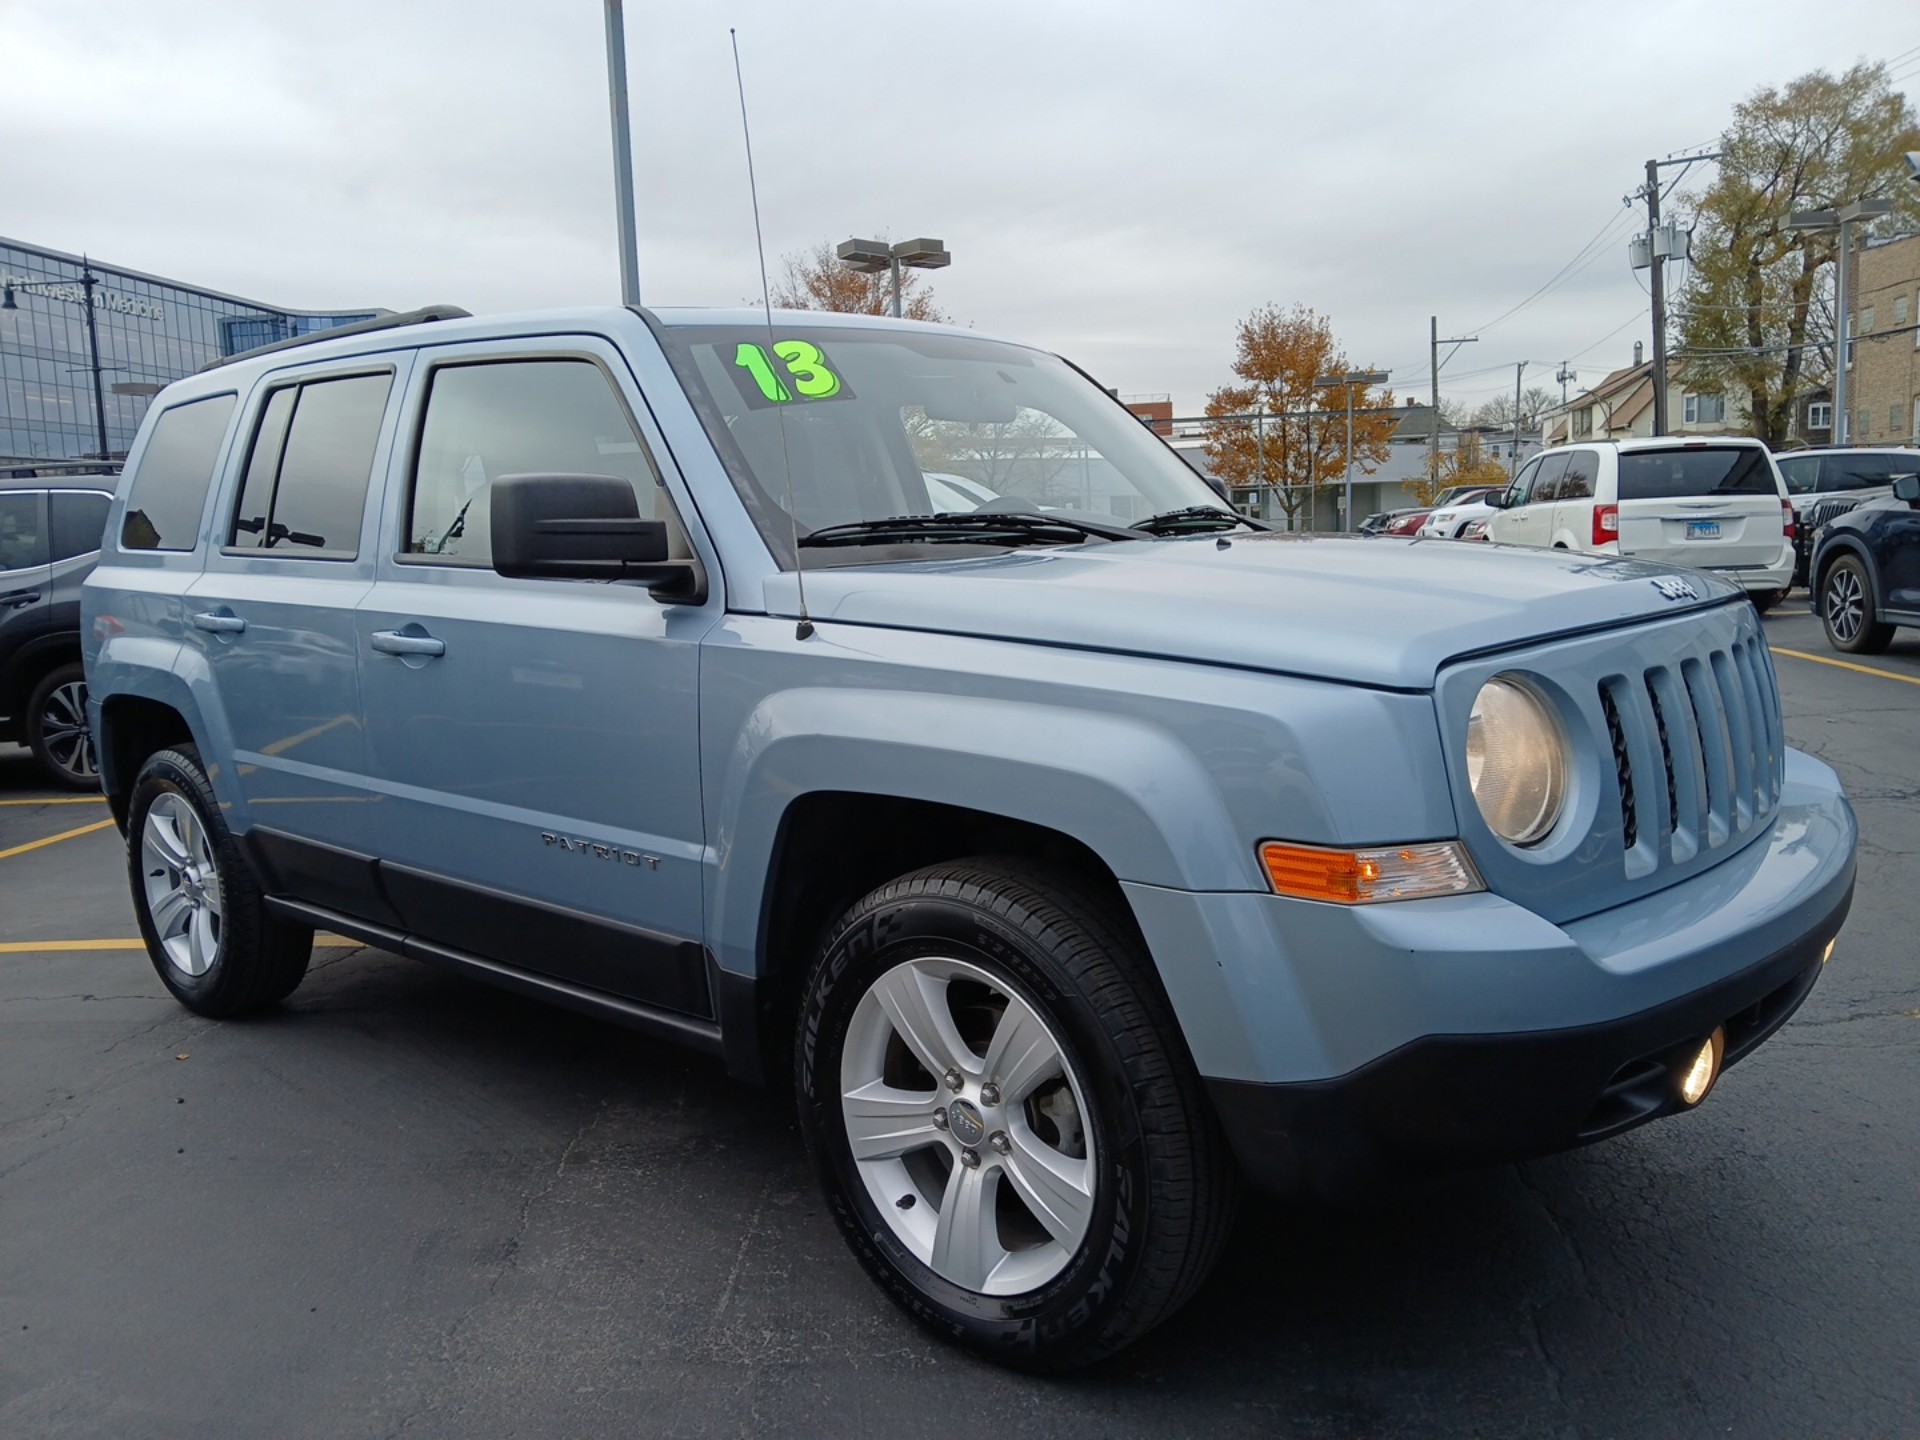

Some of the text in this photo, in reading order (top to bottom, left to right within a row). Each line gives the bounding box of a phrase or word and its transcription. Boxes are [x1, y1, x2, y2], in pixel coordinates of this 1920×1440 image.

[107, 290, 164, 321] Medicine
[735, 340, 841, 402] 13
[1651, 579, 1698, 600] Jeep
[541, 831, 661, 871] PATRIOT
